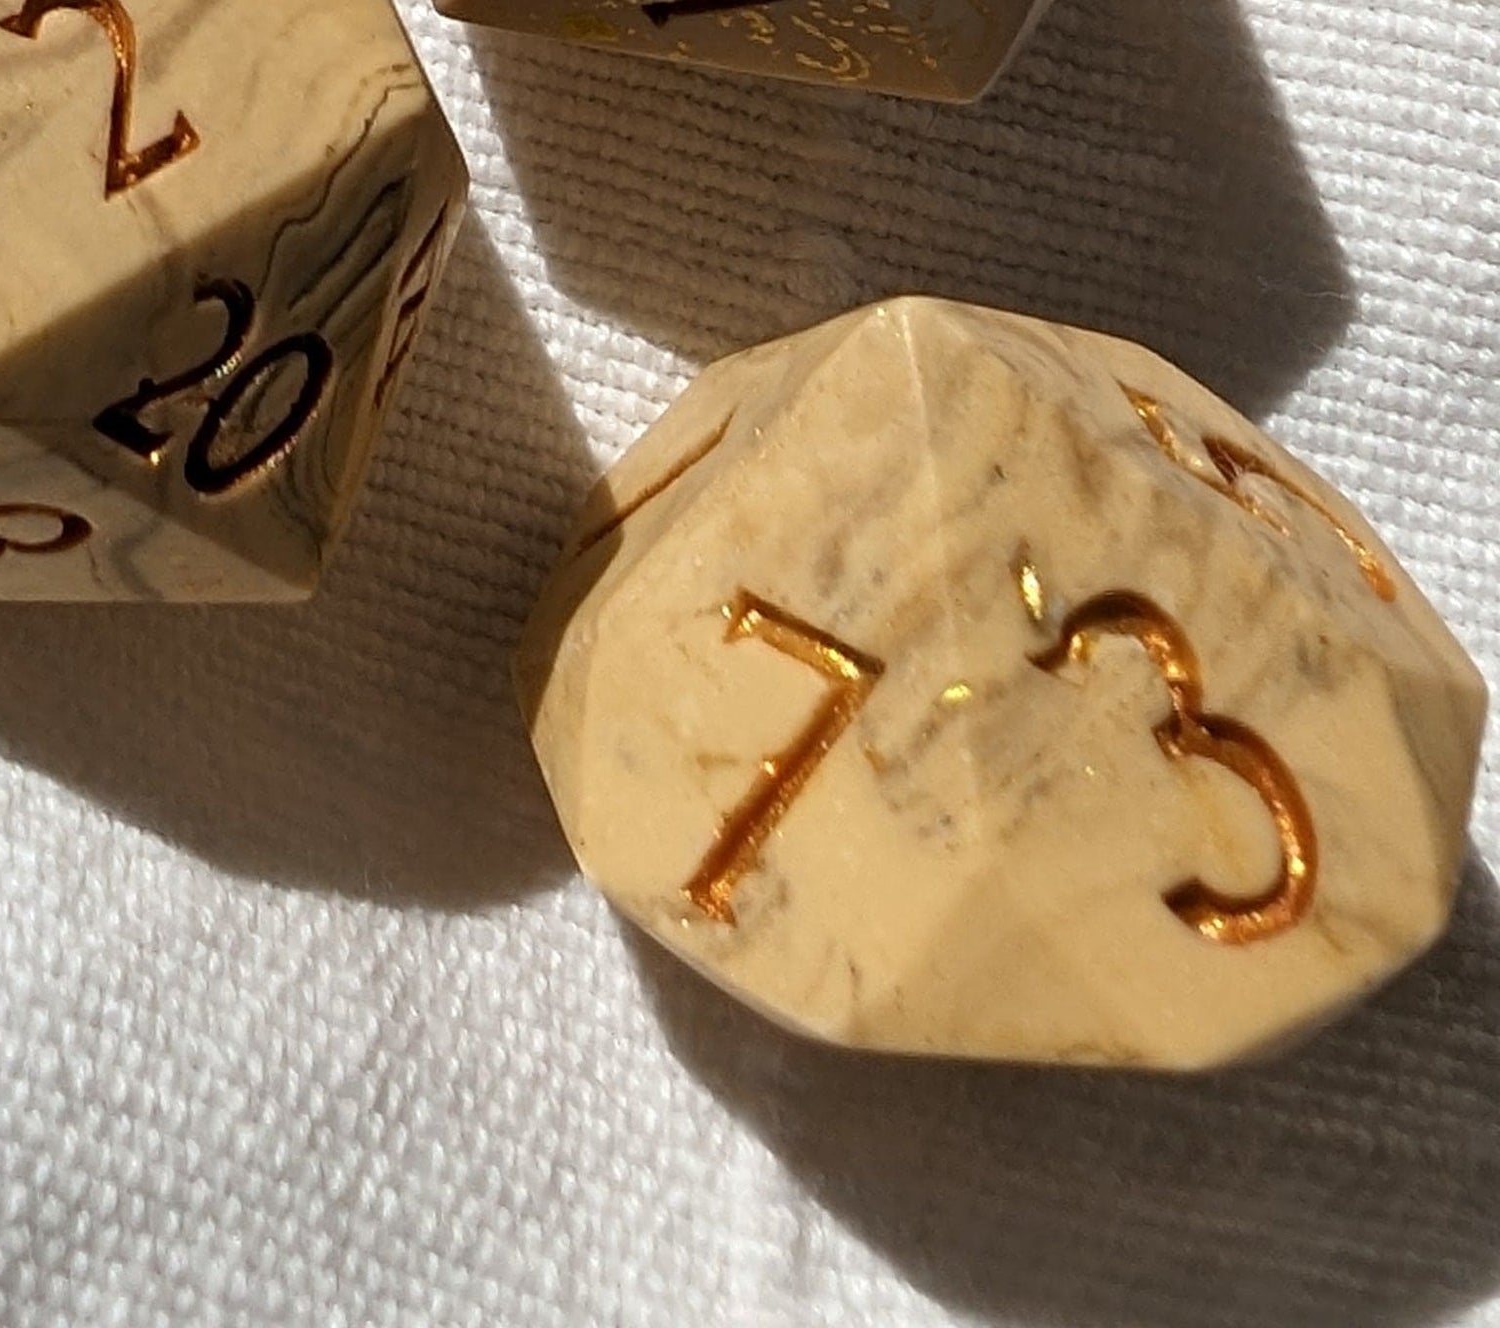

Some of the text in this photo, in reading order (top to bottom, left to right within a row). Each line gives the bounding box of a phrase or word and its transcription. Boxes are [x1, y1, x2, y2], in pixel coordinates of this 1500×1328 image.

[92, 272, 334, 498] 20
[681, 587, 888, 928] 7
[1028, 589, 1320, 945] 3
